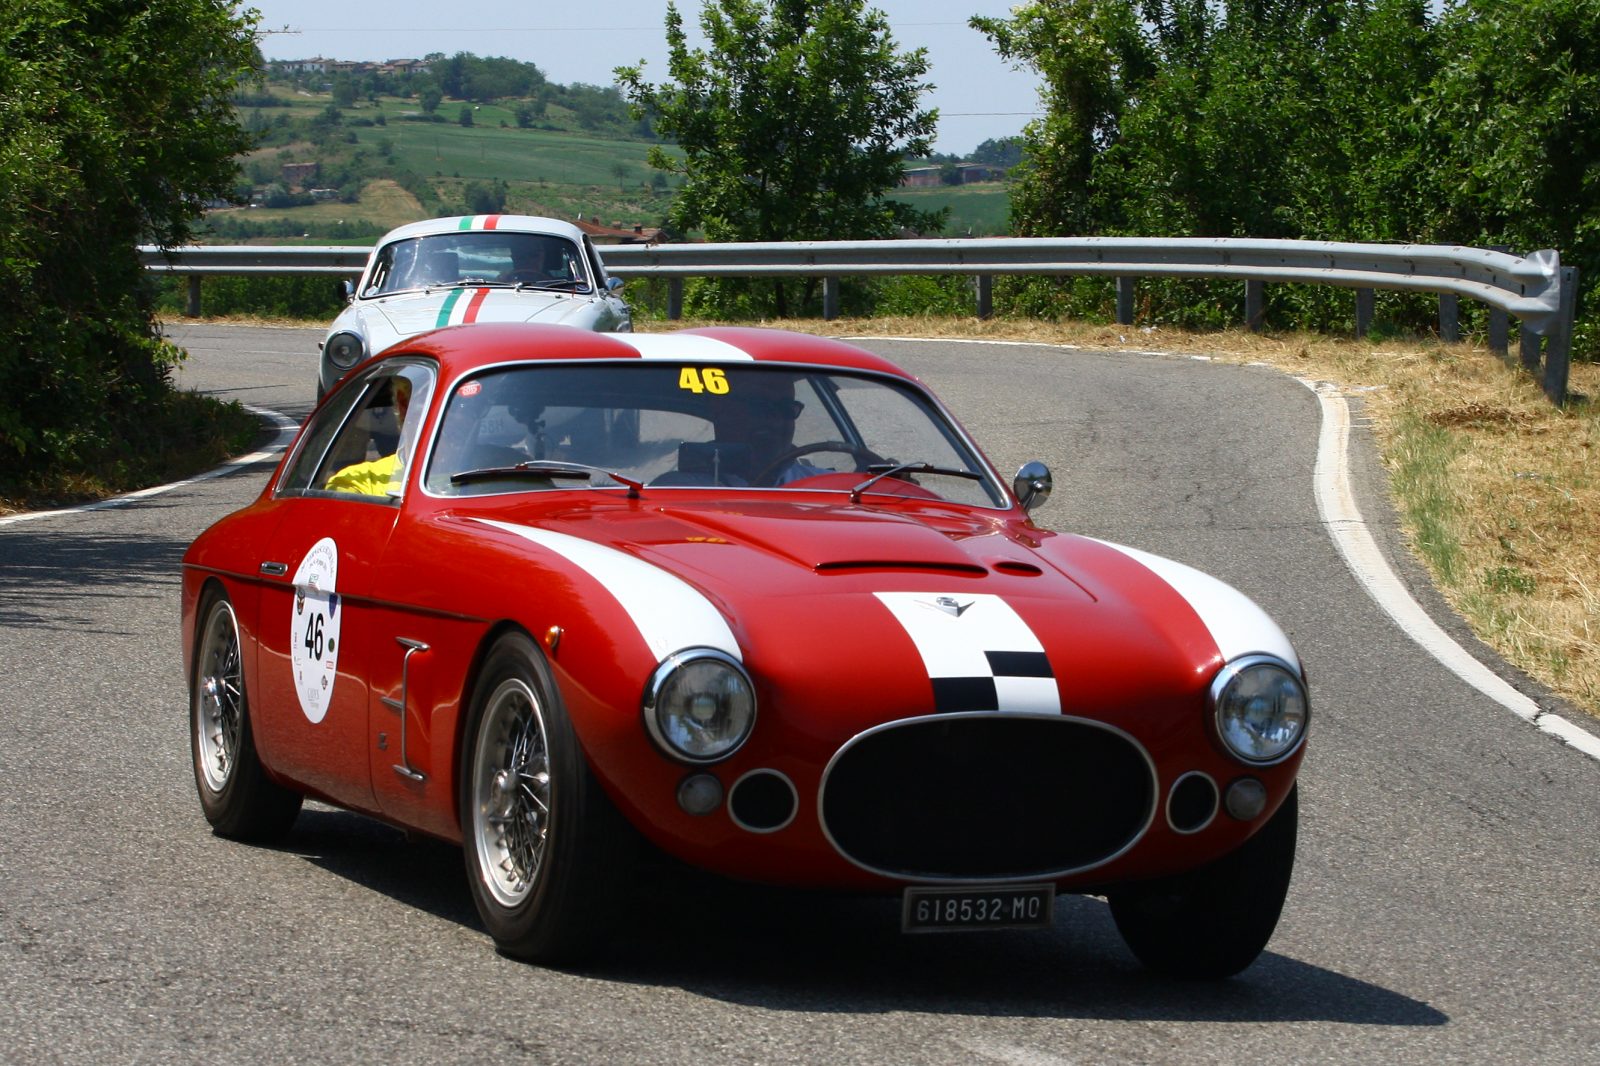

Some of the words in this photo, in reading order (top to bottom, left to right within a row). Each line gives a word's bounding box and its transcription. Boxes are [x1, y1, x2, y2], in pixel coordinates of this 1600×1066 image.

[679, 367, 730, 395] 46
[305, 612, 324, 661] 46
[917, 898, 1003, 921] 618532
[1012, 896, 1040, 919] MO
